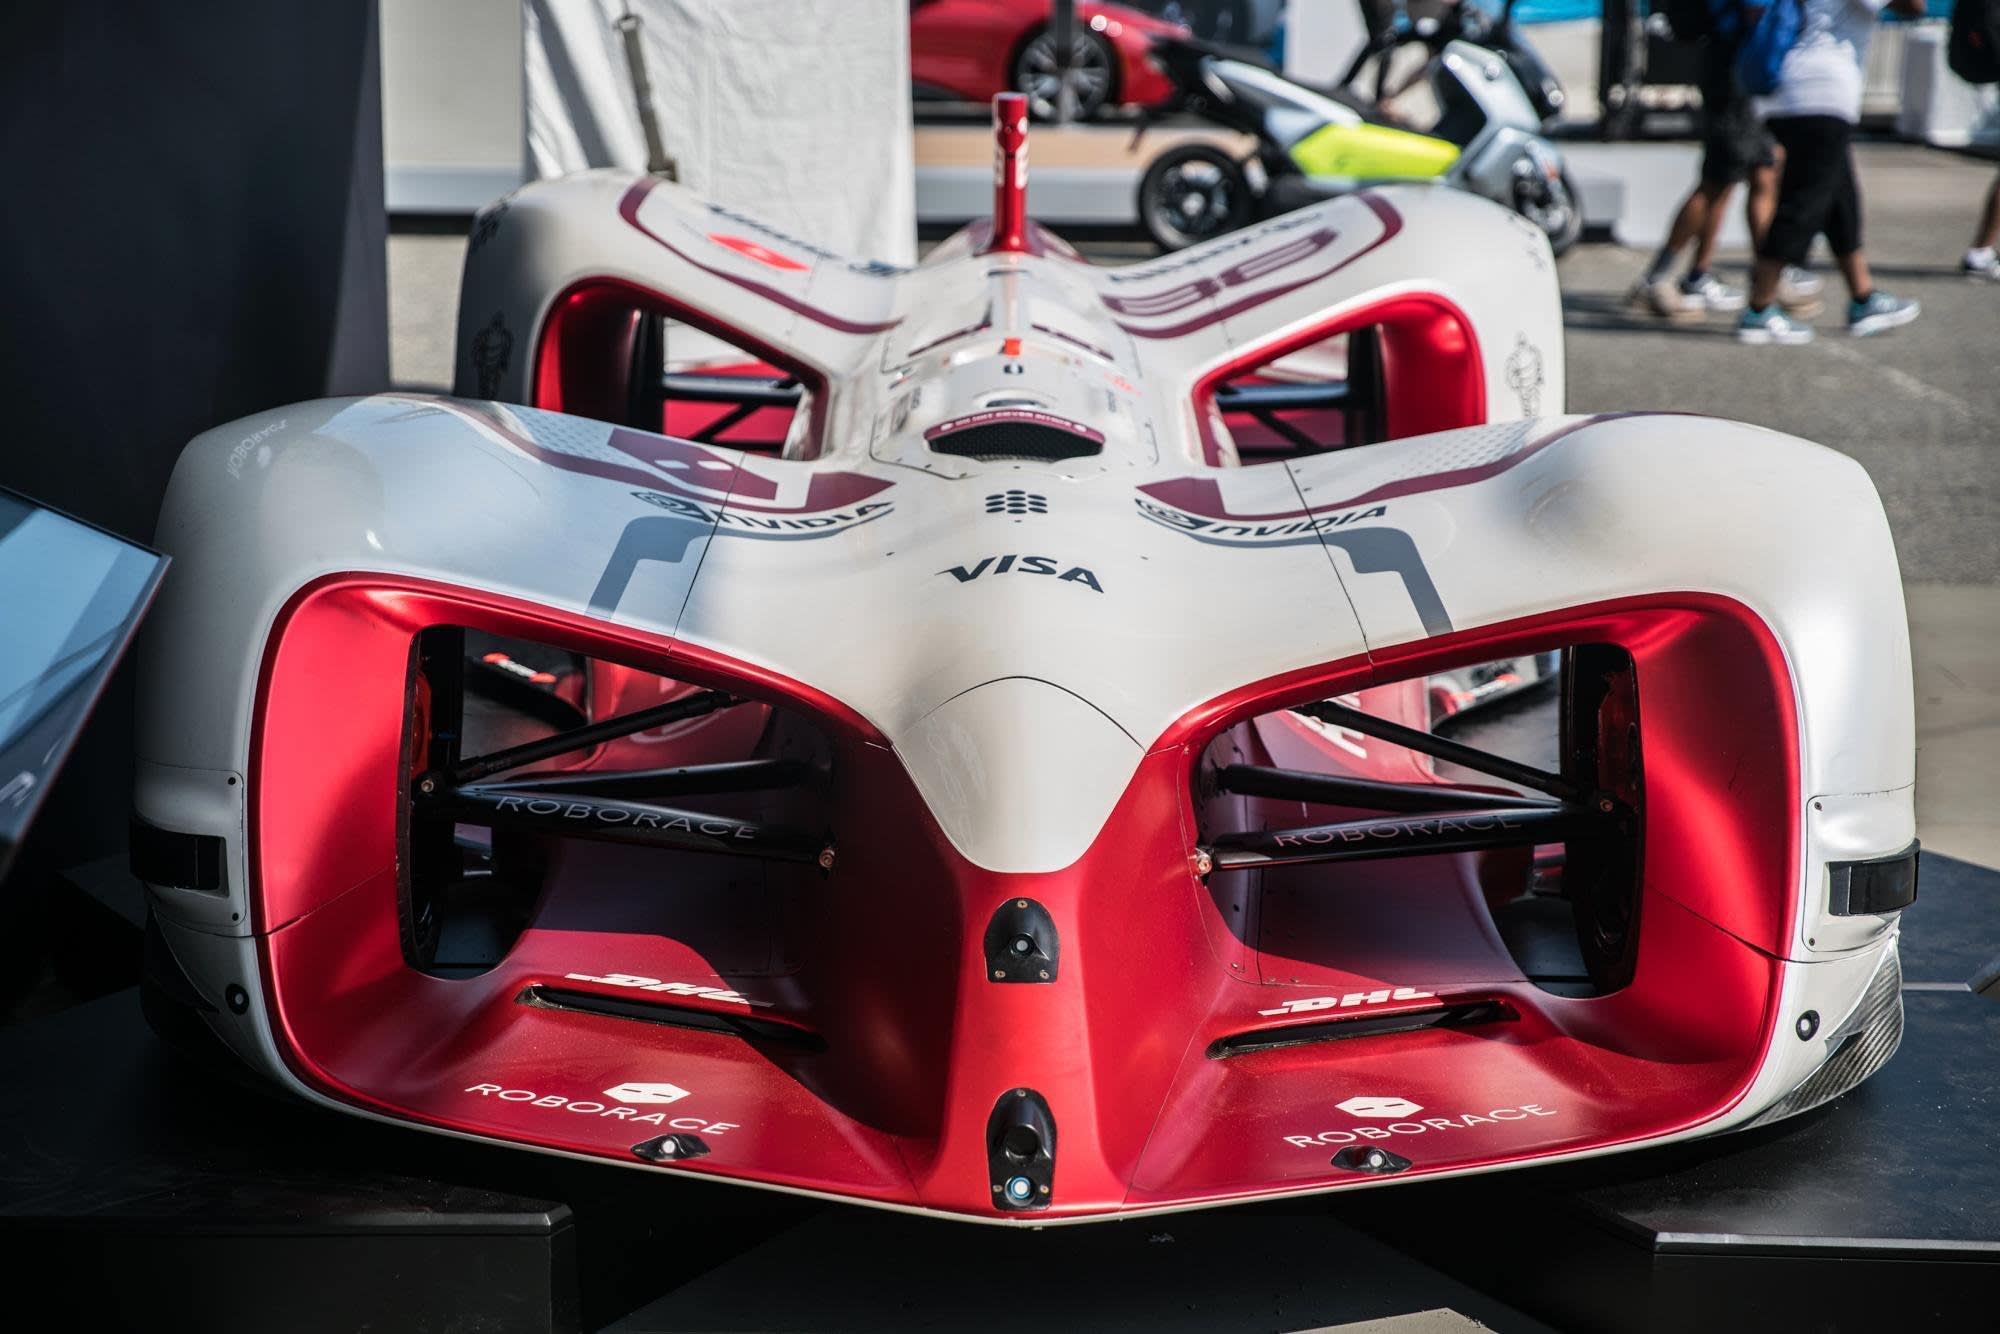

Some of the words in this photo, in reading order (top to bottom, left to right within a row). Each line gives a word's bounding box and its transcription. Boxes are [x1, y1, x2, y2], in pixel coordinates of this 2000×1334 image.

[934, 554, 1104, 593] VISA
[495, 796, 761, 839] ROBORACE
[1273, 815, 1522, 847] ROBORACE
[600, 973, 752, 1005] DHL
[1281, 987, 1436, 1013] DHL
[465, 1083, 740, 1135] ROBORACE
[1283, 1104, 1557, 1148] ROBORACE
